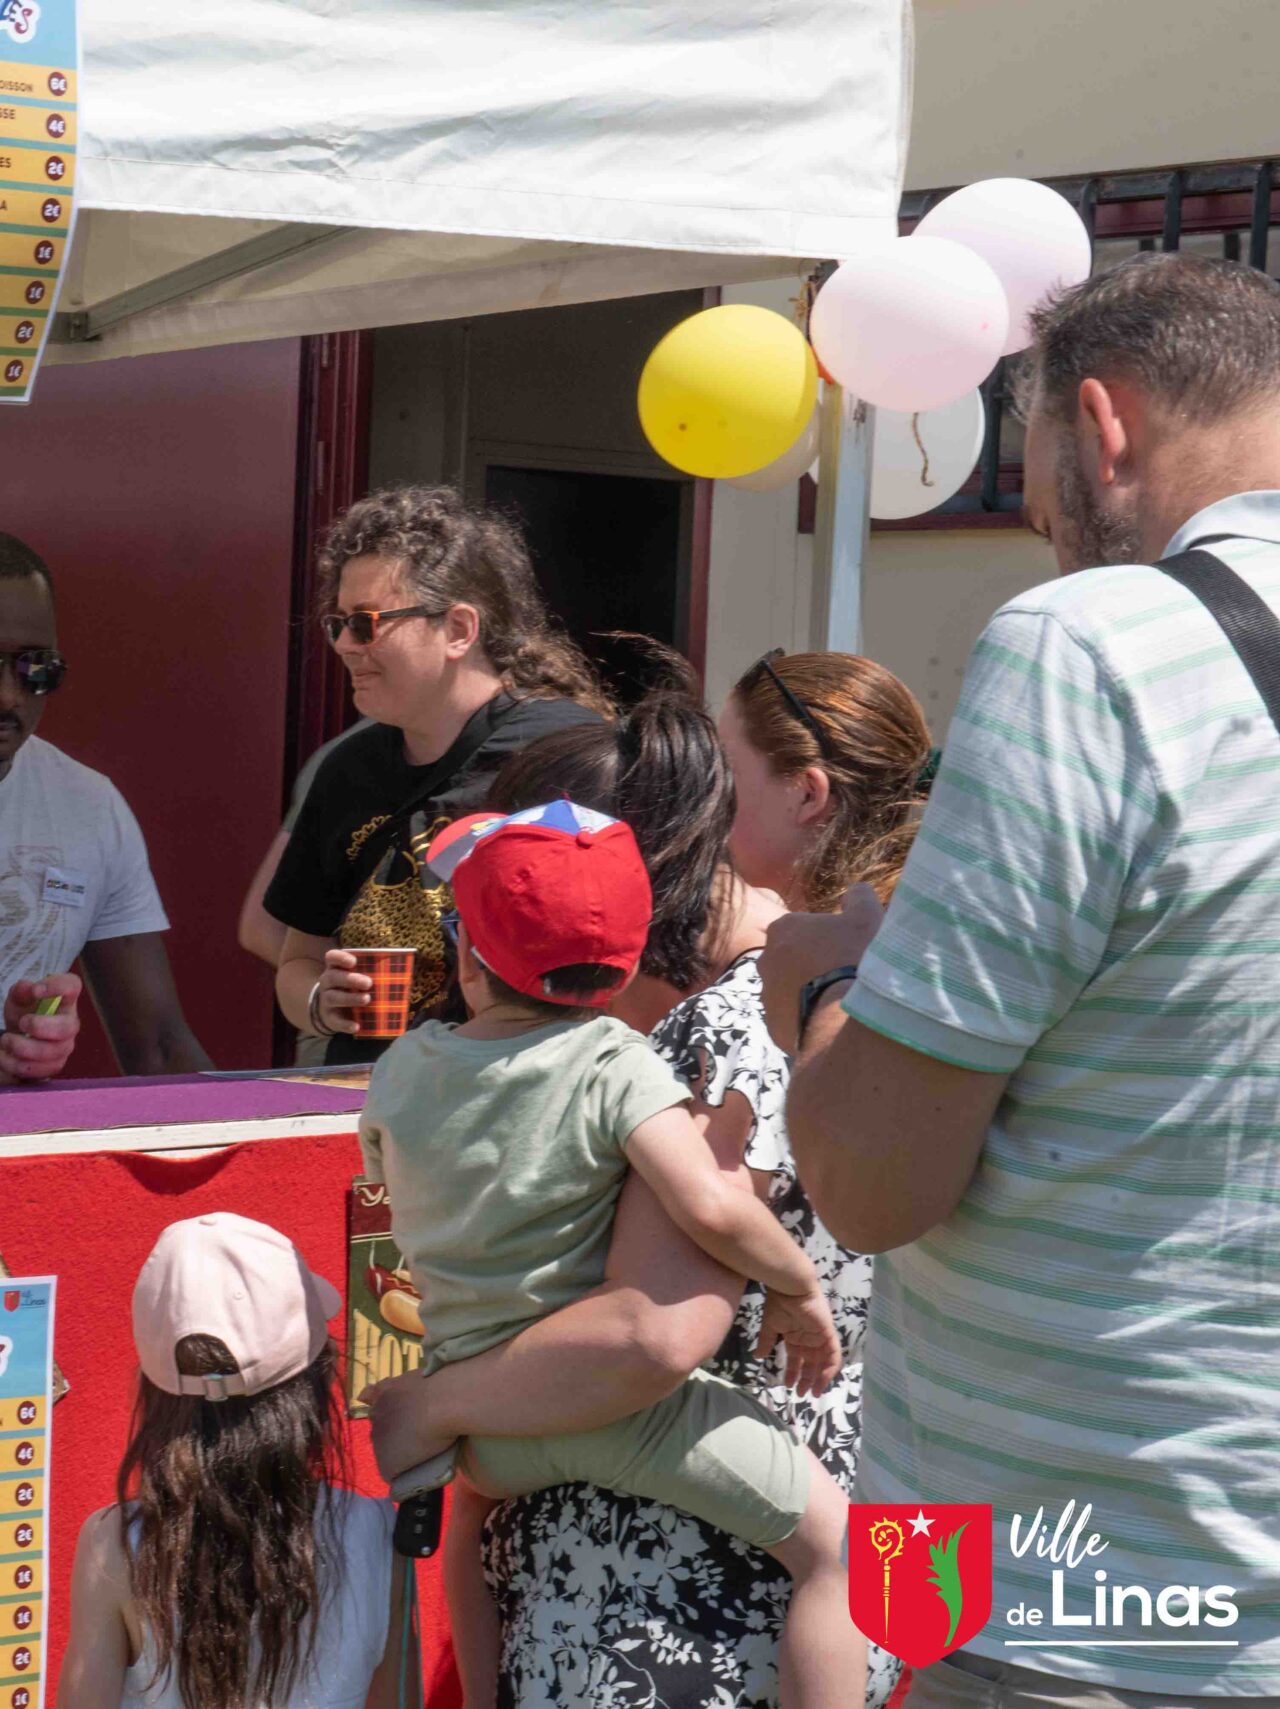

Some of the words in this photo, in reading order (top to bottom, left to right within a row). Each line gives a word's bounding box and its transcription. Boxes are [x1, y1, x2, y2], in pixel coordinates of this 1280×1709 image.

[50, 77, 67, 91] 6€
[48, 120, 65, 133] 4€
[48, 161, 64, 175] 2€
[43, 204, 60, 217] 2€
[37, 247, 52, 259] 1€
[29, 287, 43, 299] 1€
[18, 326, 33, 338] 2€
[8, 366, 21, 378] 1€
[19, 1406, 35, 1419] 6€
[18, 1447, 34, 1460] 4€
[18, 1488, 33, 1501] 2€
[17, 1528, 33, 1541] 2€
[18, 1570, 32, 1583] 1€
[17, 1611, 31, 1624] 1€
[15, 1652, 31, 1665] 2€
[15, 1693, 28, 1706] 1€
